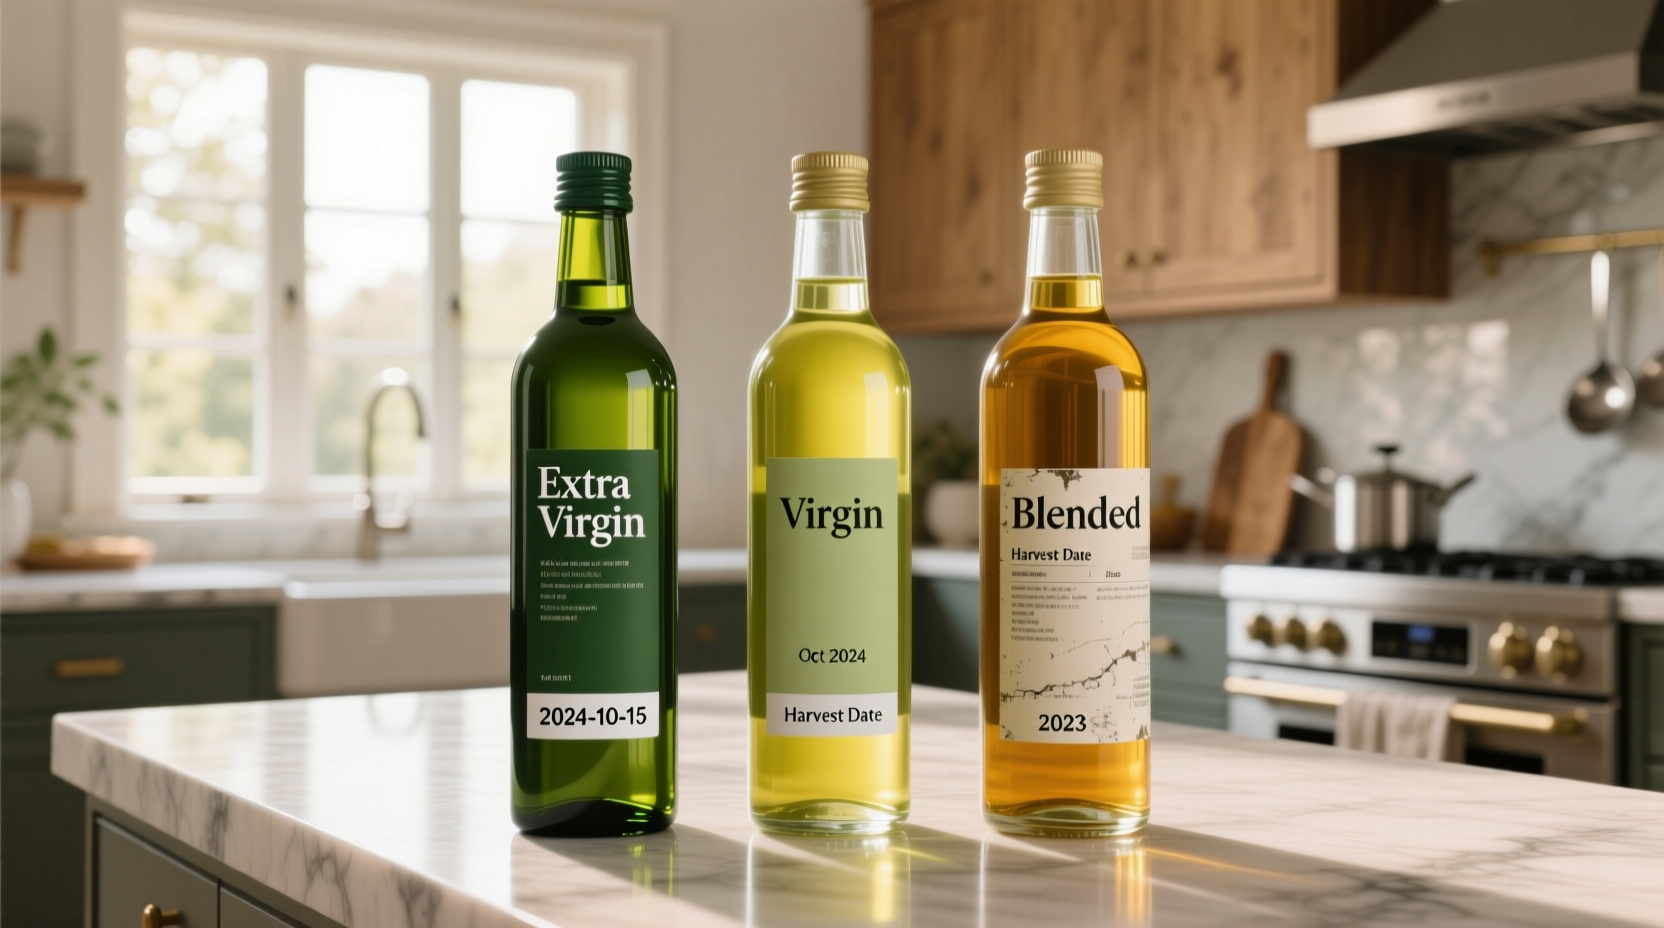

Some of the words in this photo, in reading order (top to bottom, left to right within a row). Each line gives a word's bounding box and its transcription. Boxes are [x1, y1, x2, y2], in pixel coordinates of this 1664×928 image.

[537, 466, 631, 500] Extra
[780, 497, 884, 539] Virgin
[1011, 495, 1141, 530] Blended
[537, 504, 646, 548] Virgin
[1011, 547, 1059, 561] Harvest
[1063, 548, 1092, 561] Date
[798, 647, 825, 664] Oct
[829, 648, 867, 664] 2024
[539, 706, 647, 726] 2024-10-15
[784, 706, 844, 723] Harvest
[848, 706, 883, 723] Date
[1038, 714, 1087, 732] 2023
